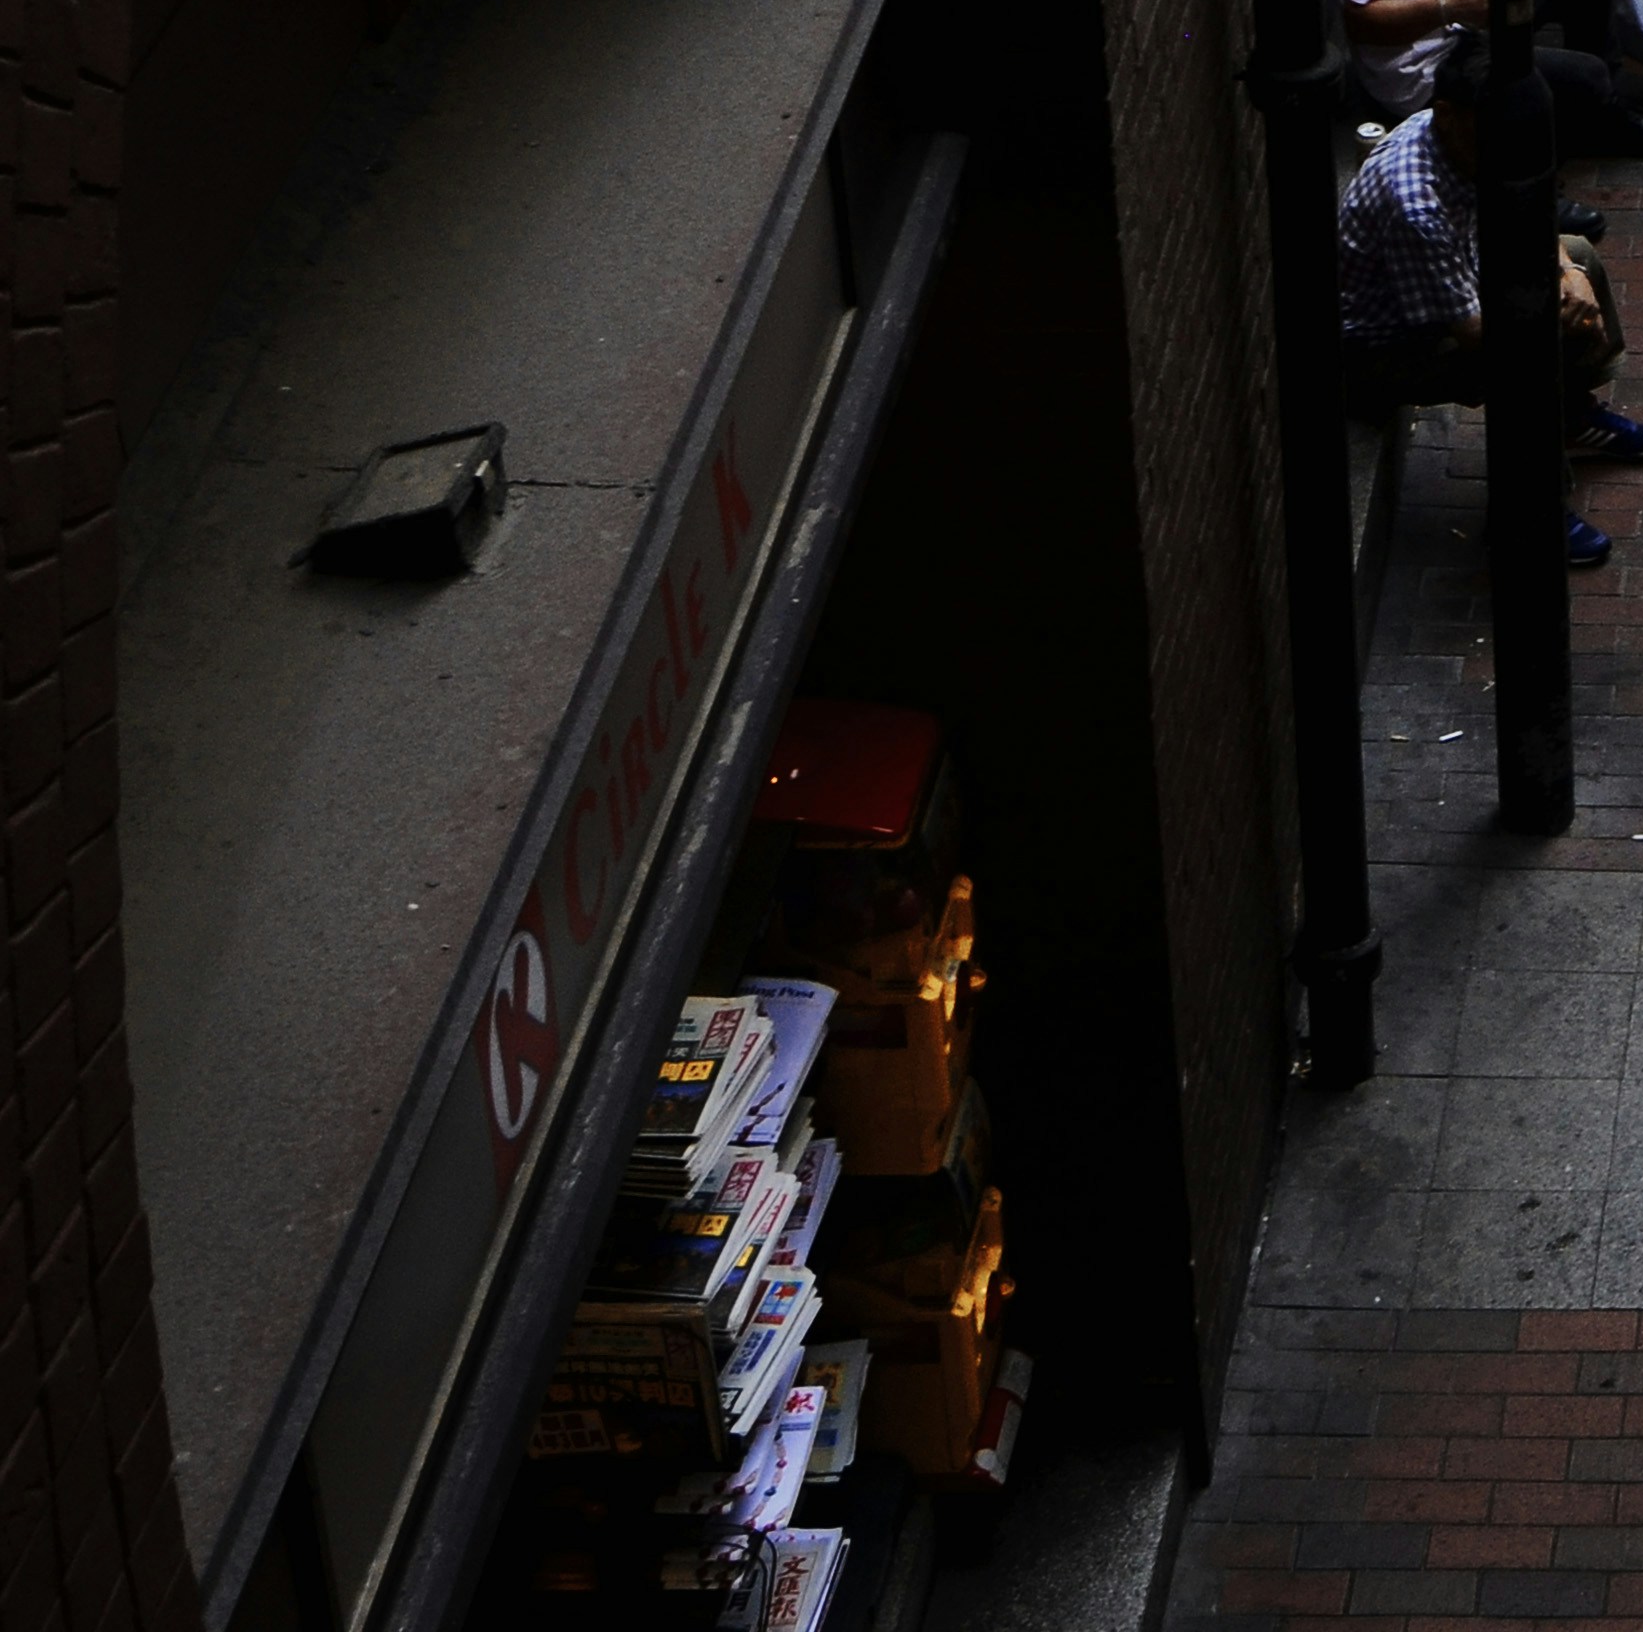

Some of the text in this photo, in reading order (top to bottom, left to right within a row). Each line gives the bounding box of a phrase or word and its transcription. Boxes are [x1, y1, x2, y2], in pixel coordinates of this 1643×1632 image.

[711, 417, 754, 575] K
[738, 984, 816, 1000] ning Post
[769, 1555, 810, 1619] 文匯報
